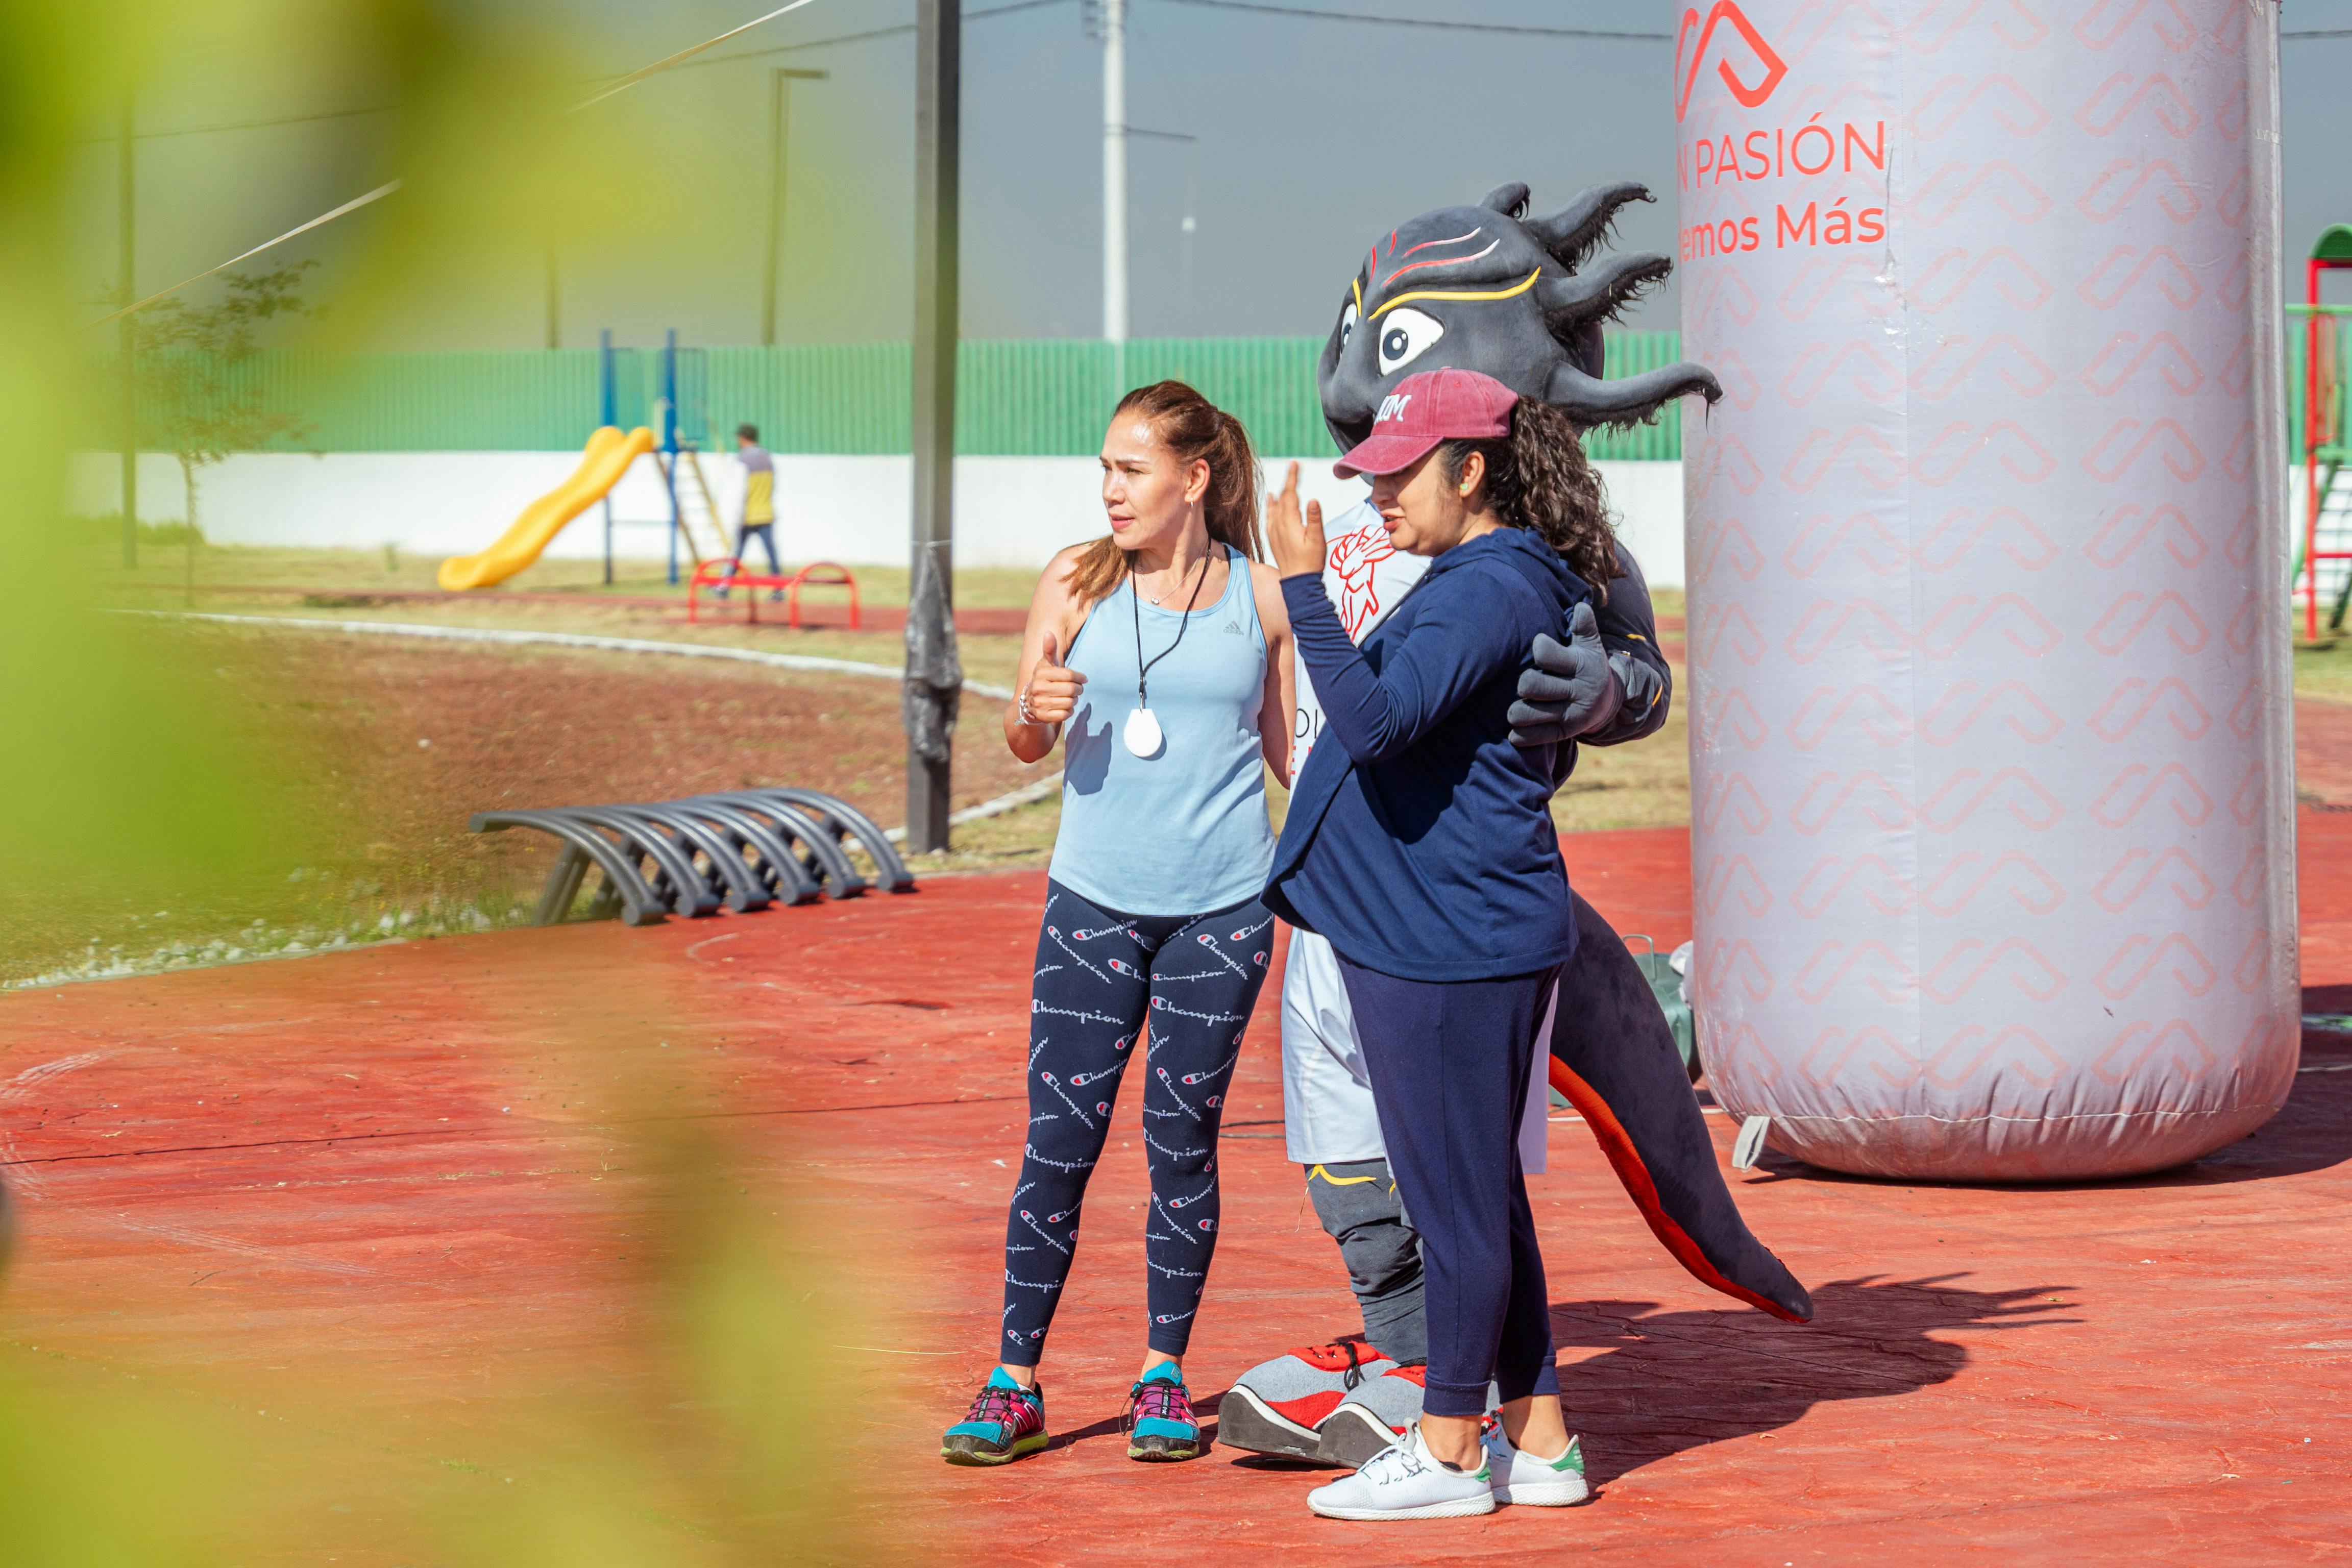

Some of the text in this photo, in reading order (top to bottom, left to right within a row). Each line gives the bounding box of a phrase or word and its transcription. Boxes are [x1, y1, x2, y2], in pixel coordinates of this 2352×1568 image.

[1696, 111, 1884, 188] PASIÓN
[1776, 196, 1885, 249] Más
[1072, 919, 1138, 941] Champion
[1047, 925, 1112, 984] Champion
[1152, 971, 1227, 983] Champion
[1196, 933, 1248, 981] Champion
[1031, 998, 1125, 1025] Champion
[1150, 995, 1245, 1027] Champion
[1041, 1071, 1095, 1130] Champion
[1156, 1067, 1202, 1122] Champion
[1025, 1143, 1095, 1173] Champion
[1020, 1209, 1069, 1256] Champion
[1152, 1191, 1199, 1244] Champion
